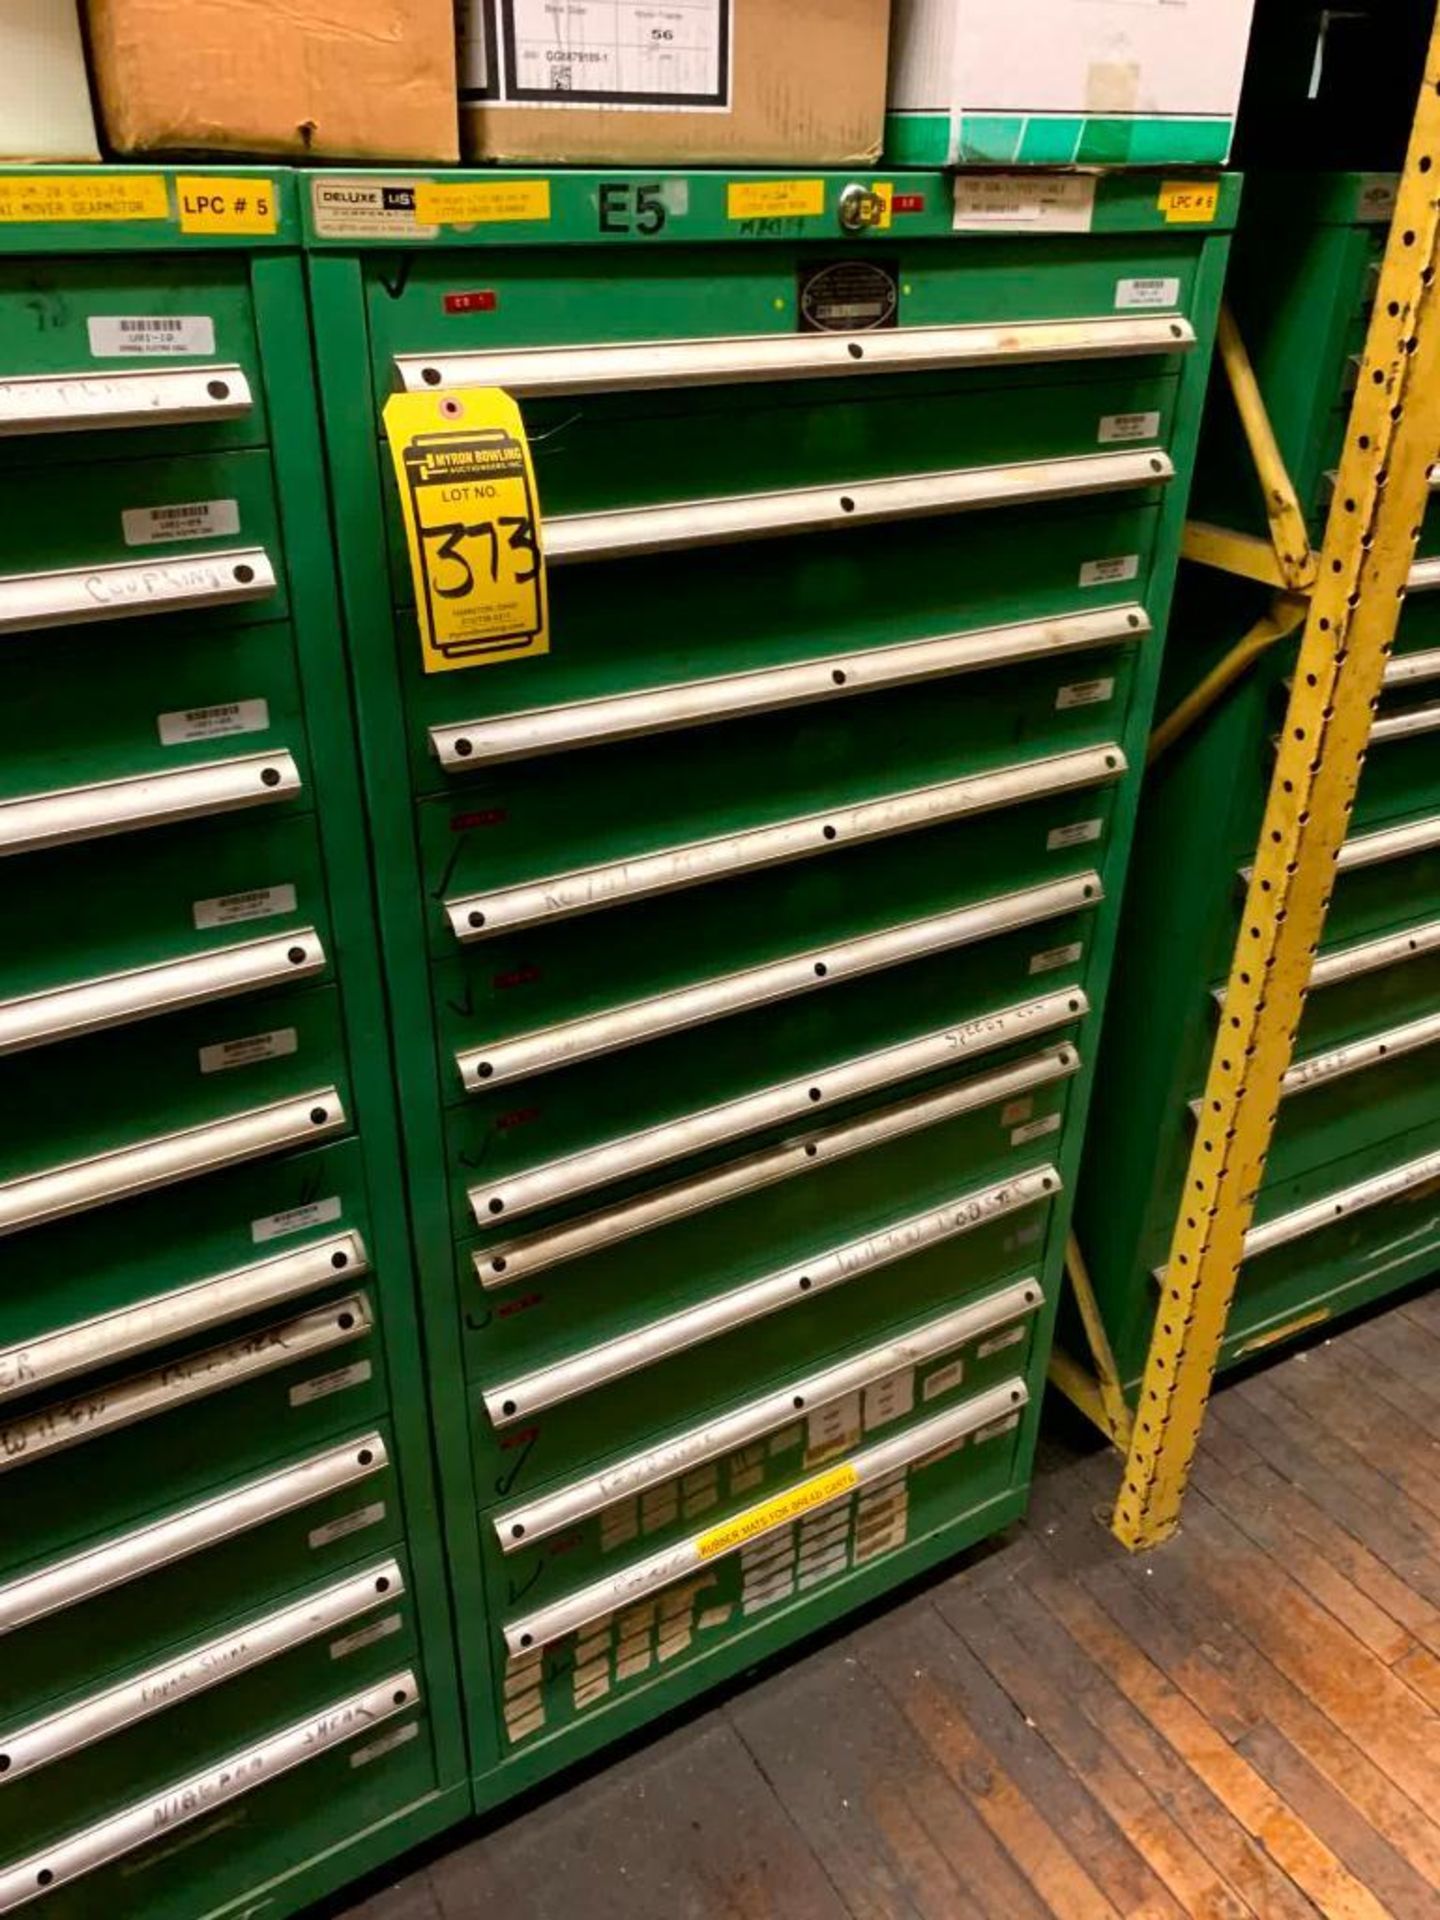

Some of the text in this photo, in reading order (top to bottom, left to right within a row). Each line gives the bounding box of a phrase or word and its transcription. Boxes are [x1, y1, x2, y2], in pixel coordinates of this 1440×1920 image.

[651, 29, 673, 40] 56
[184, 196, 268, 215] LPC # 5
[323, 192, 377, 203] DELUXE
[1170, 196, 1192, 209] LPC
[599, 183, 665, 235] E5
[435, 446, 522, 467] MYRON BOWLING
[441, 487, 469, 502] LOT
[421, 516, 542, 599] 373
